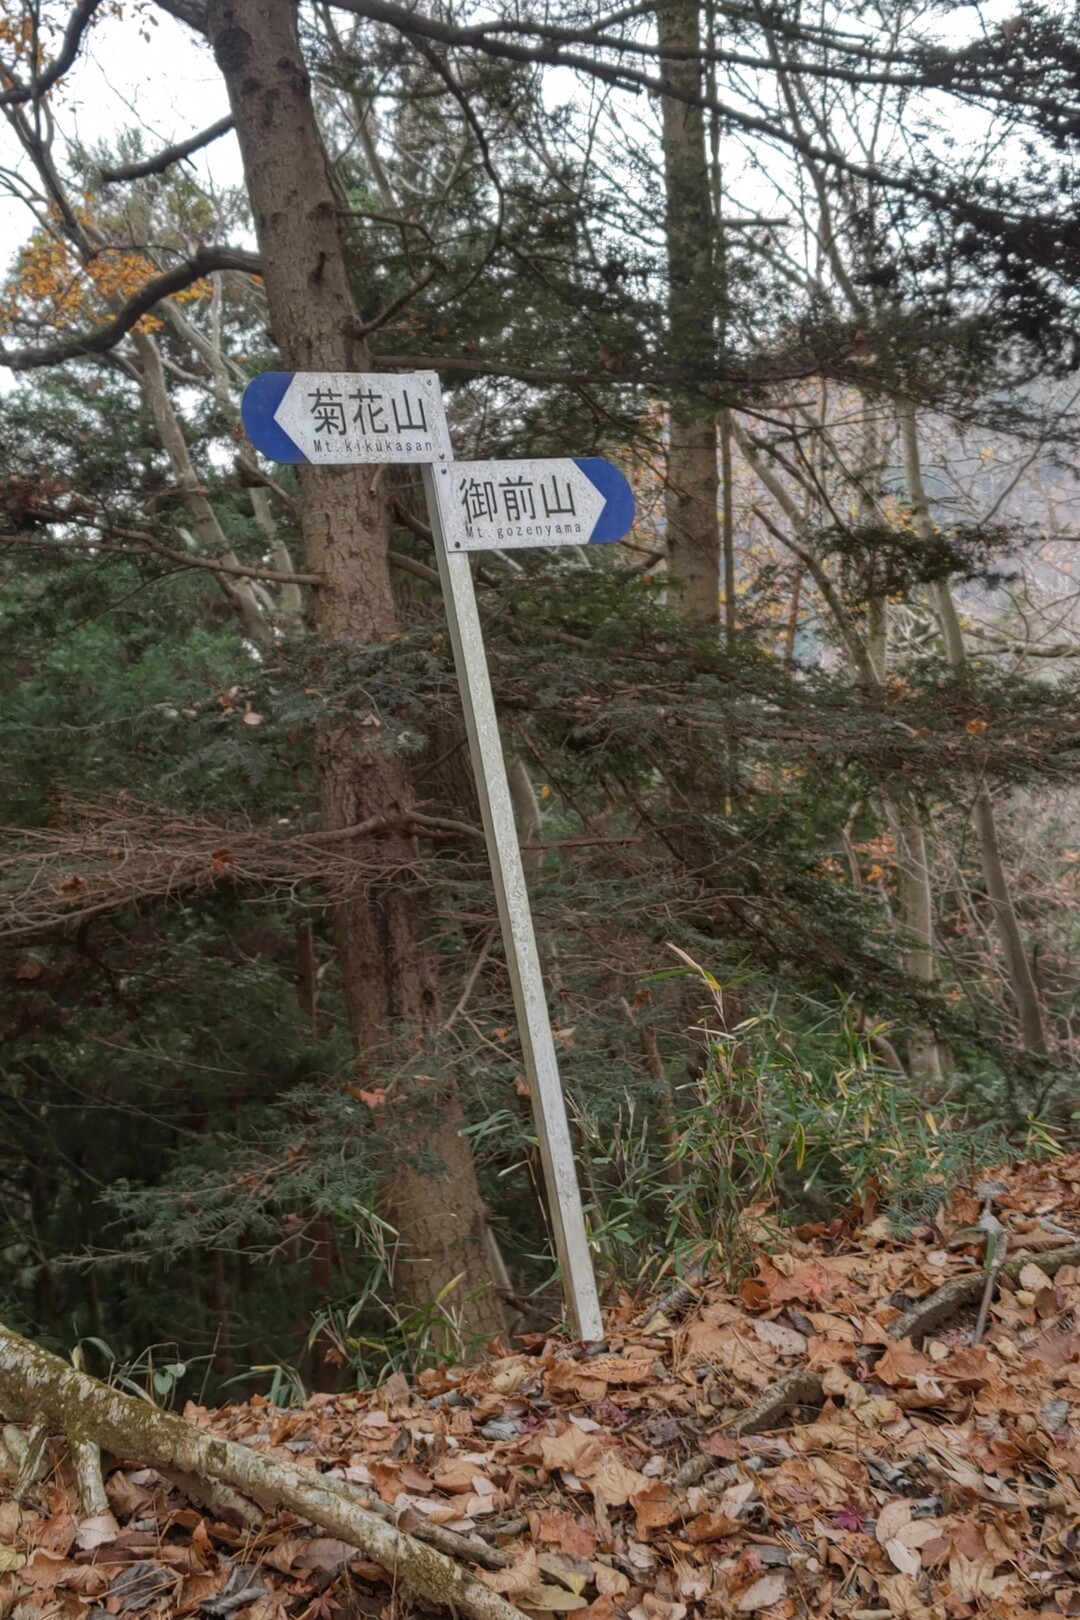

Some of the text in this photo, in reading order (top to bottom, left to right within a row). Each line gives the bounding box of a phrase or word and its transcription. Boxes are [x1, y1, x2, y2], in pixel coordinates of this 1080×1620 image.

[307, 388, 428, 436] 菊花山
[459, 475, 577, 524] 御前山
